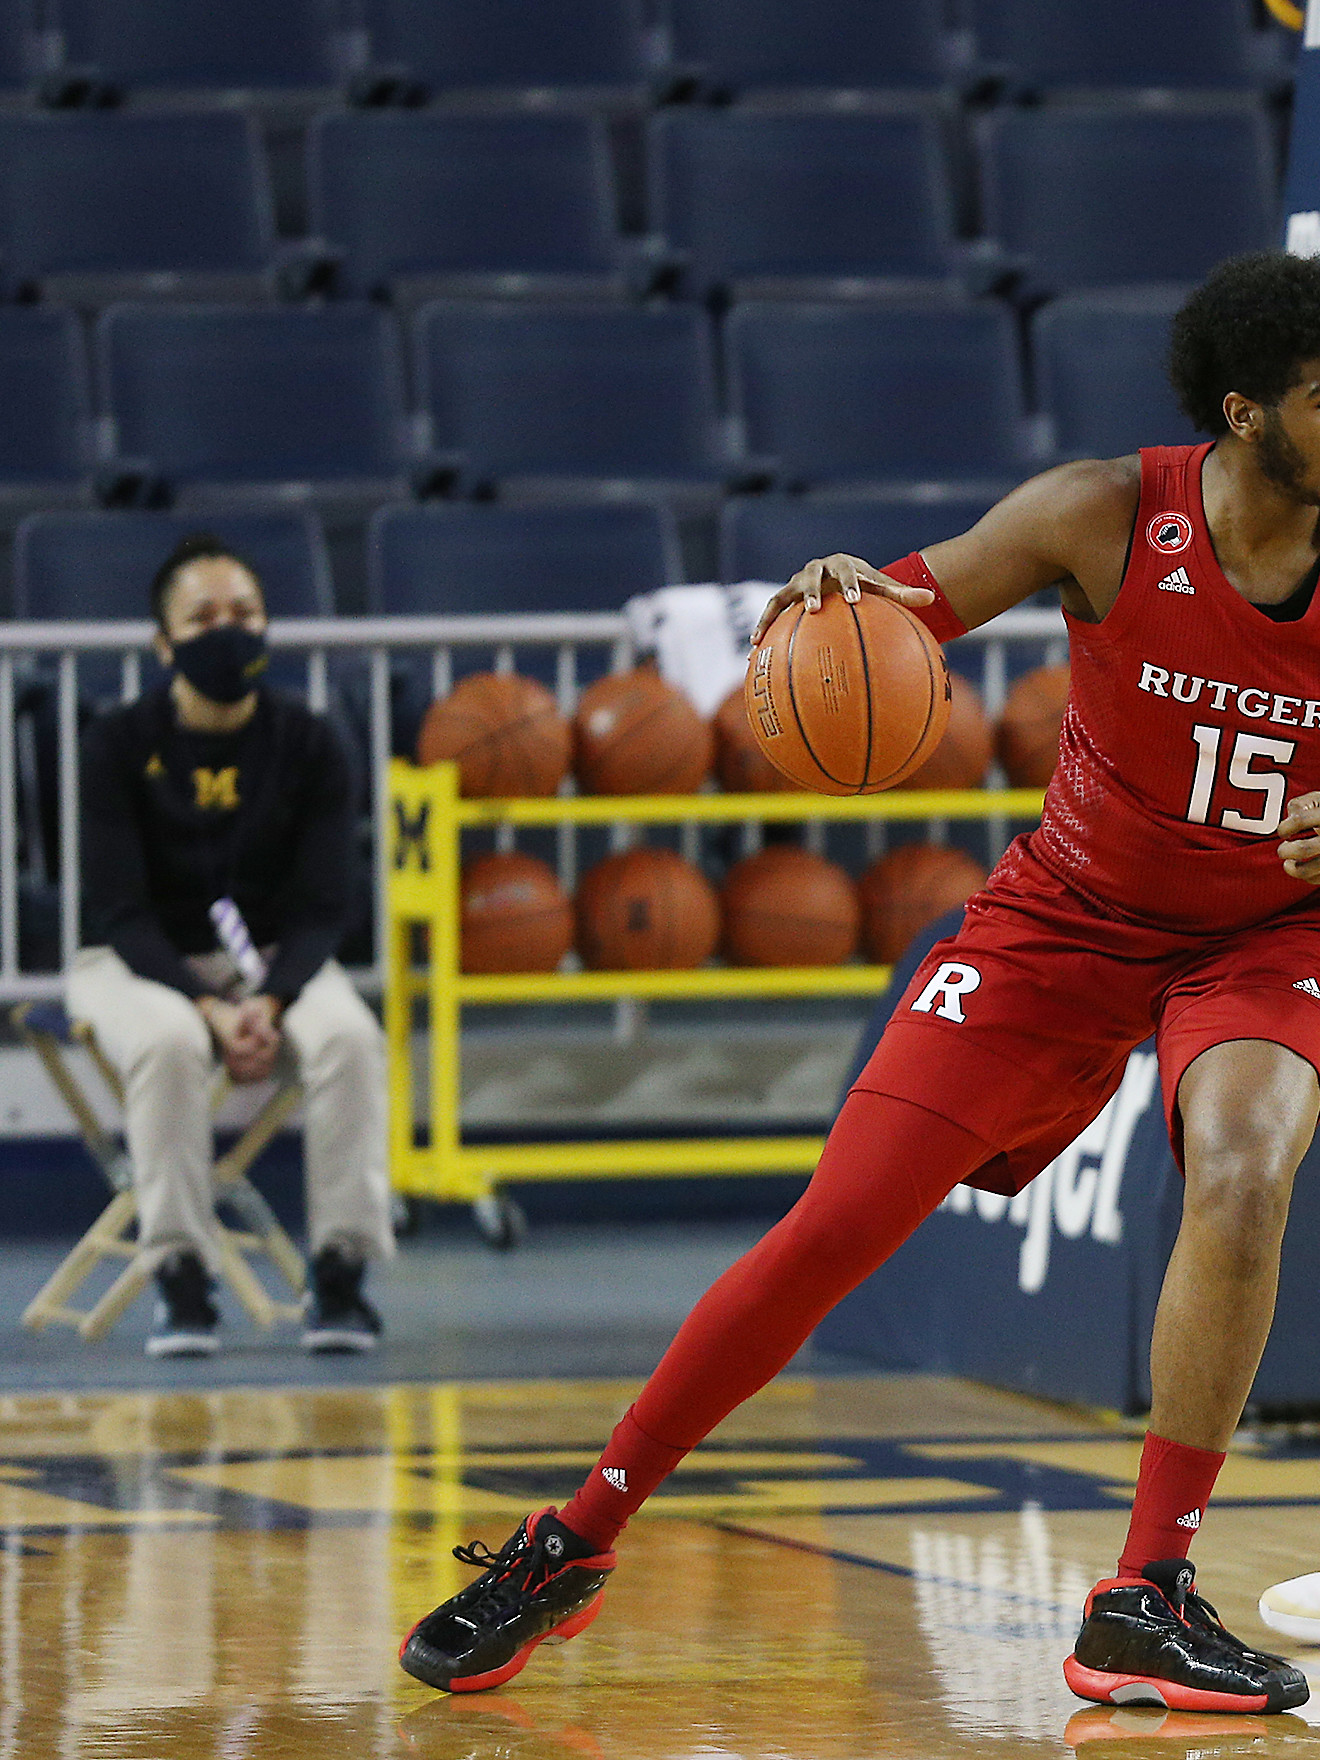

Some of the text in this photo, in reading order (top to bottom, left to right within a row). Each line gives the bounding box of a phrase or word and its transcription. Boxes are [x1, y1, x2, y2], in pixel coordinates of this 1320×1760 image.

[1157, 581, 1196, 596] adidas
[1186, 723, 1298, 836] 15
[910, 961, 983, 1025] R
